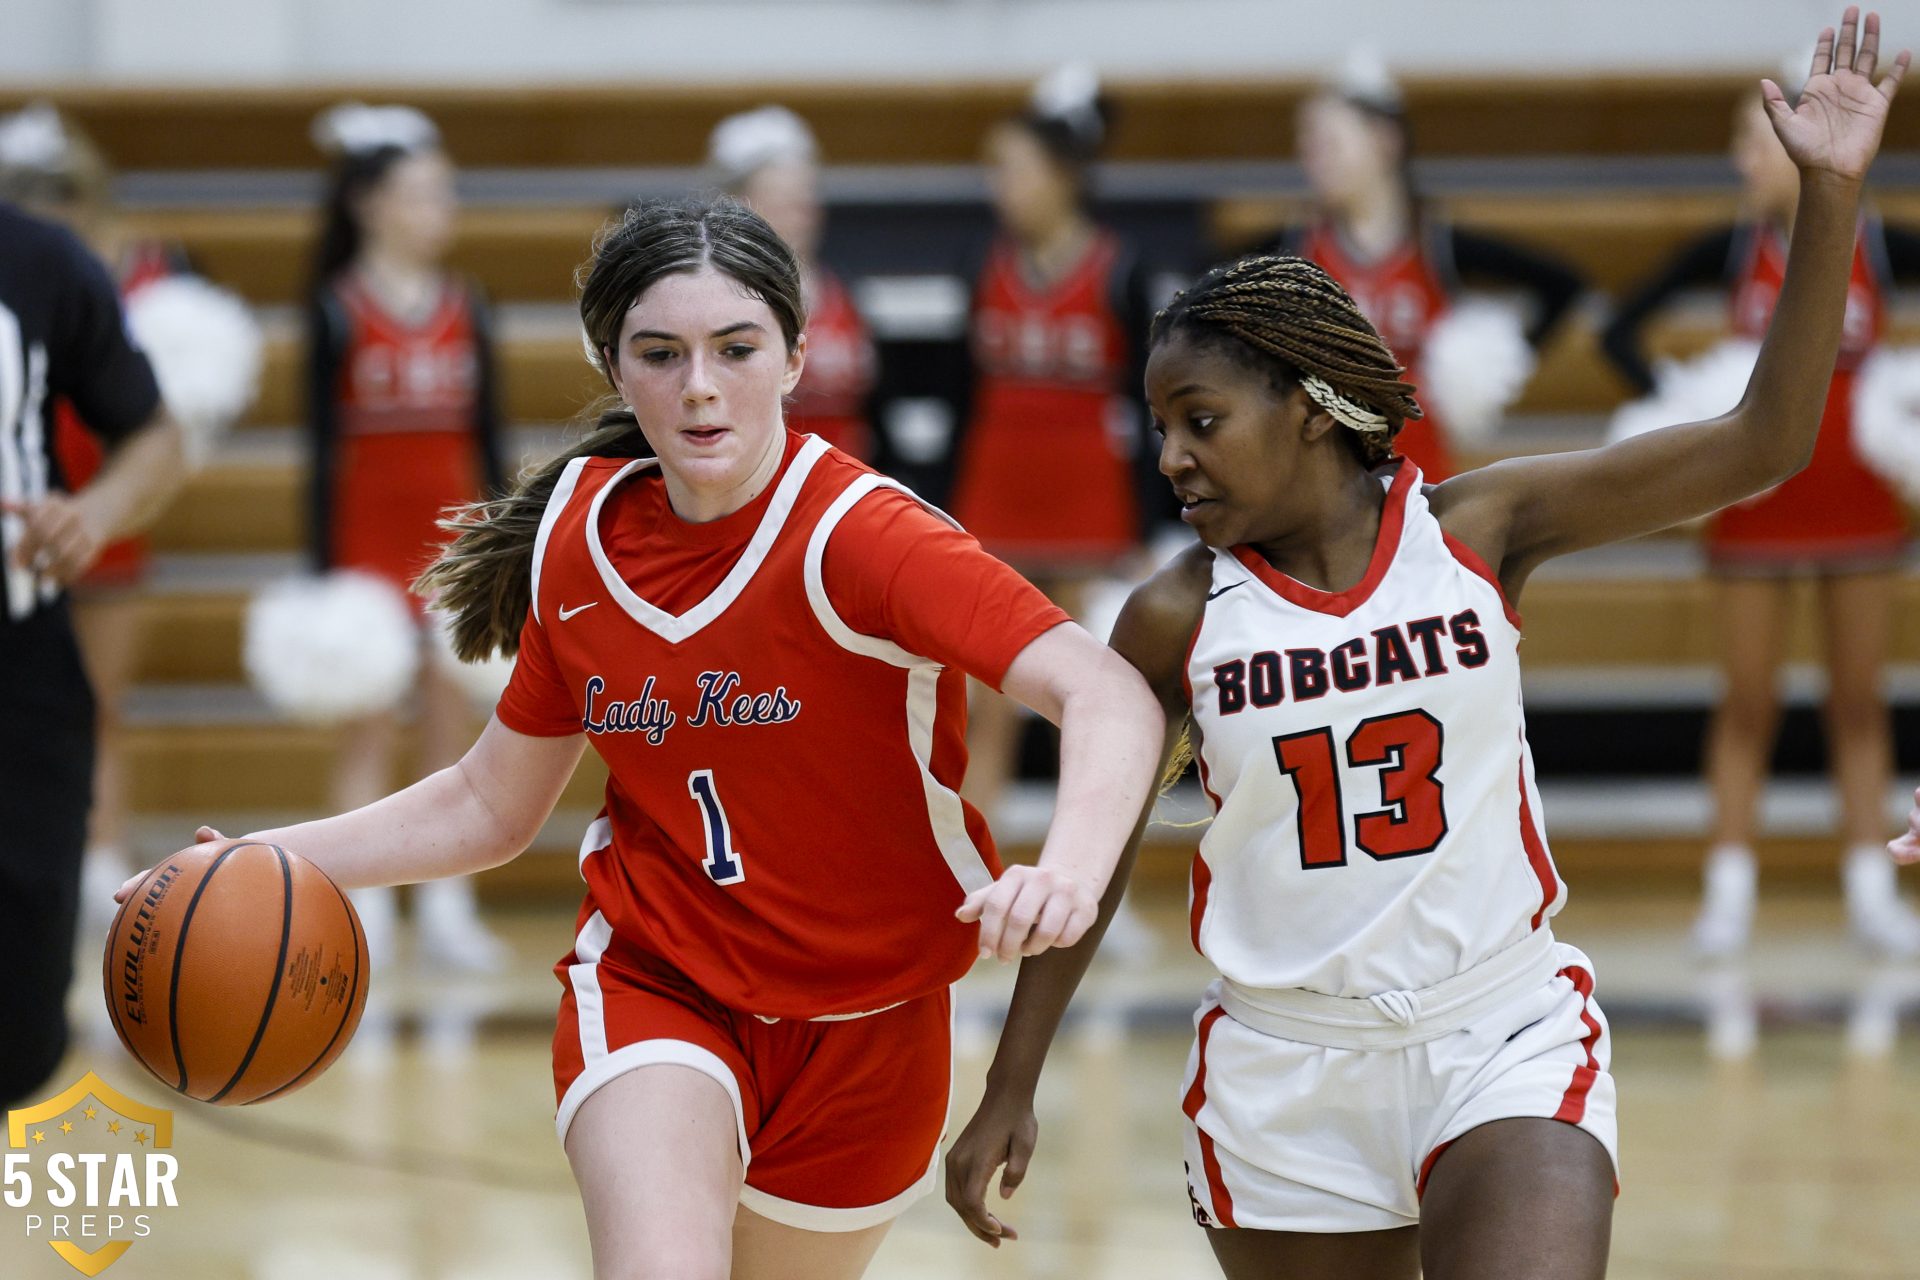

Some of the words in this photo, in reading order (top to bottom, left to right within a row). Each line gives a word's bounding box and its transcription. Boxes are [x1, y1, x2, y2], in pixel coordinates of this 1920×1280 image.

[582, 676, 676, 745] Lady
[687, 671, 801, 727] Kees
[1213, 608, 1490, 716] BOBCATS
[687, 768, 746, 886] 1
[1272, 707, 1449, 870] 13
[124, 864, 179, 1025] EVOLUTION
